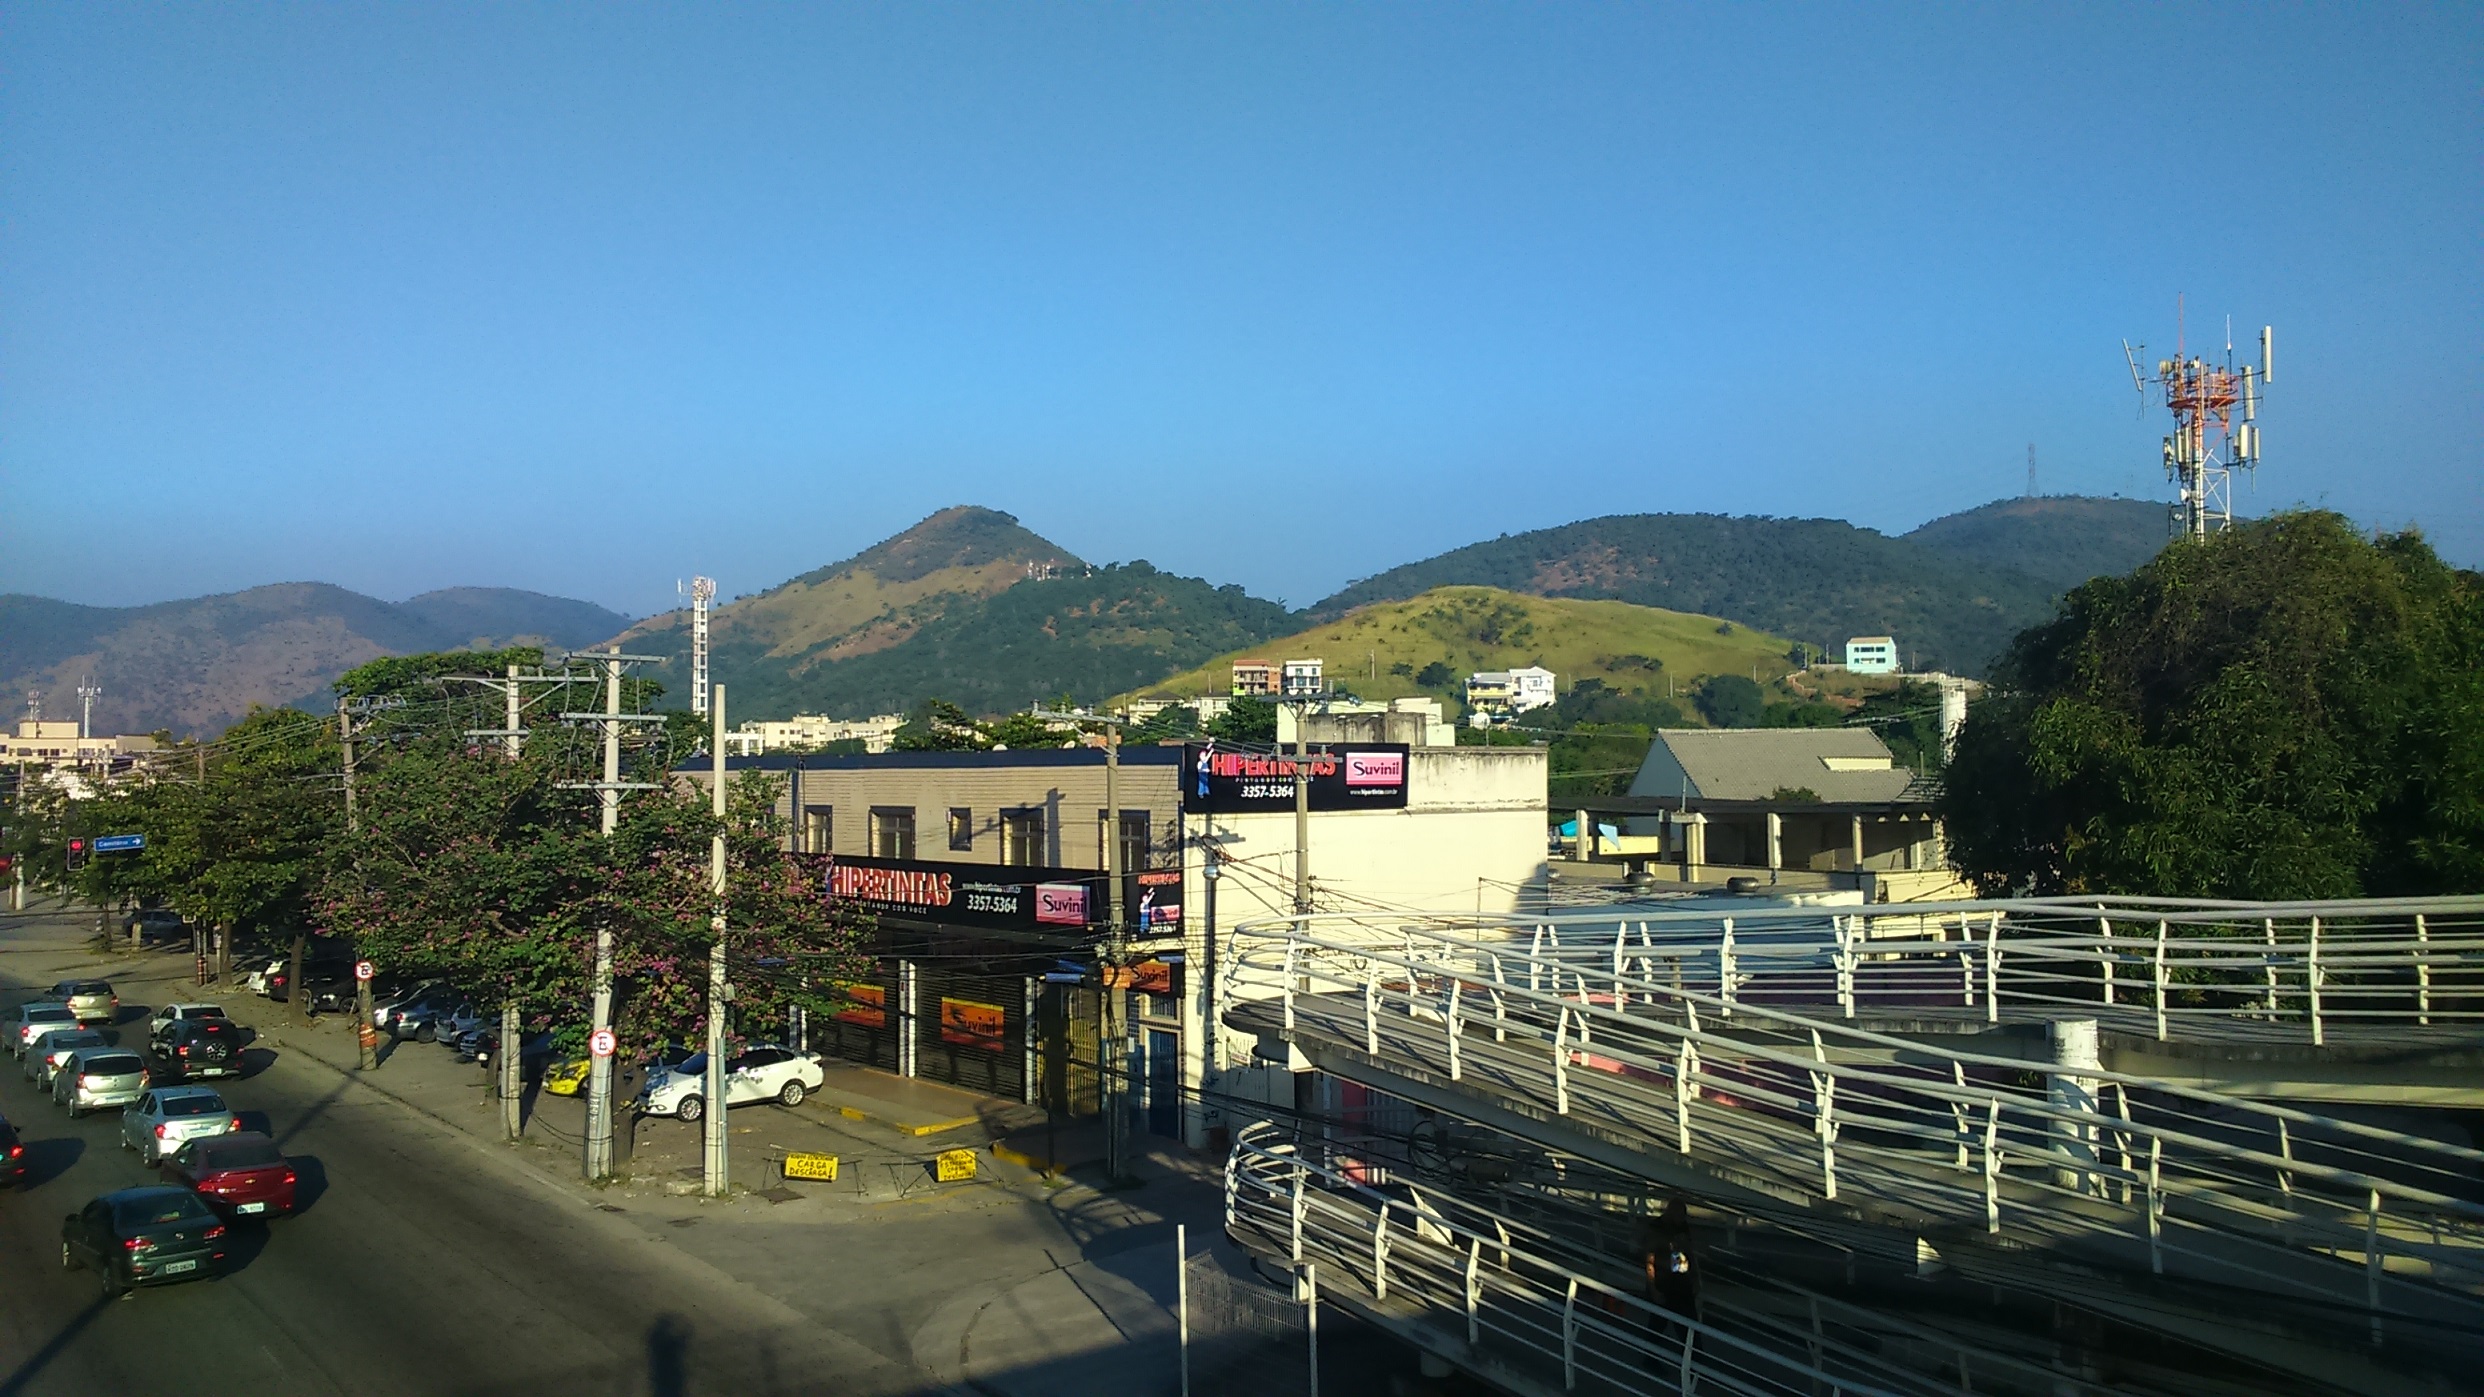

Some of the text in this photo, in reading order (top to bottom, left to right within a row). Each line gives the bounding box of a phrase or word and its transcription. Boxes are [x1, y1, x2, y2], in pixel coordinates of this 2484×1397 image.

[1353, 761, 1400, 776] Suvinil
[832, 865, 953, 906] HIPERTINTAS
[1043, 894, 1088, 914] Suvinil
[797, 1160, 827, 1170] CARGA
